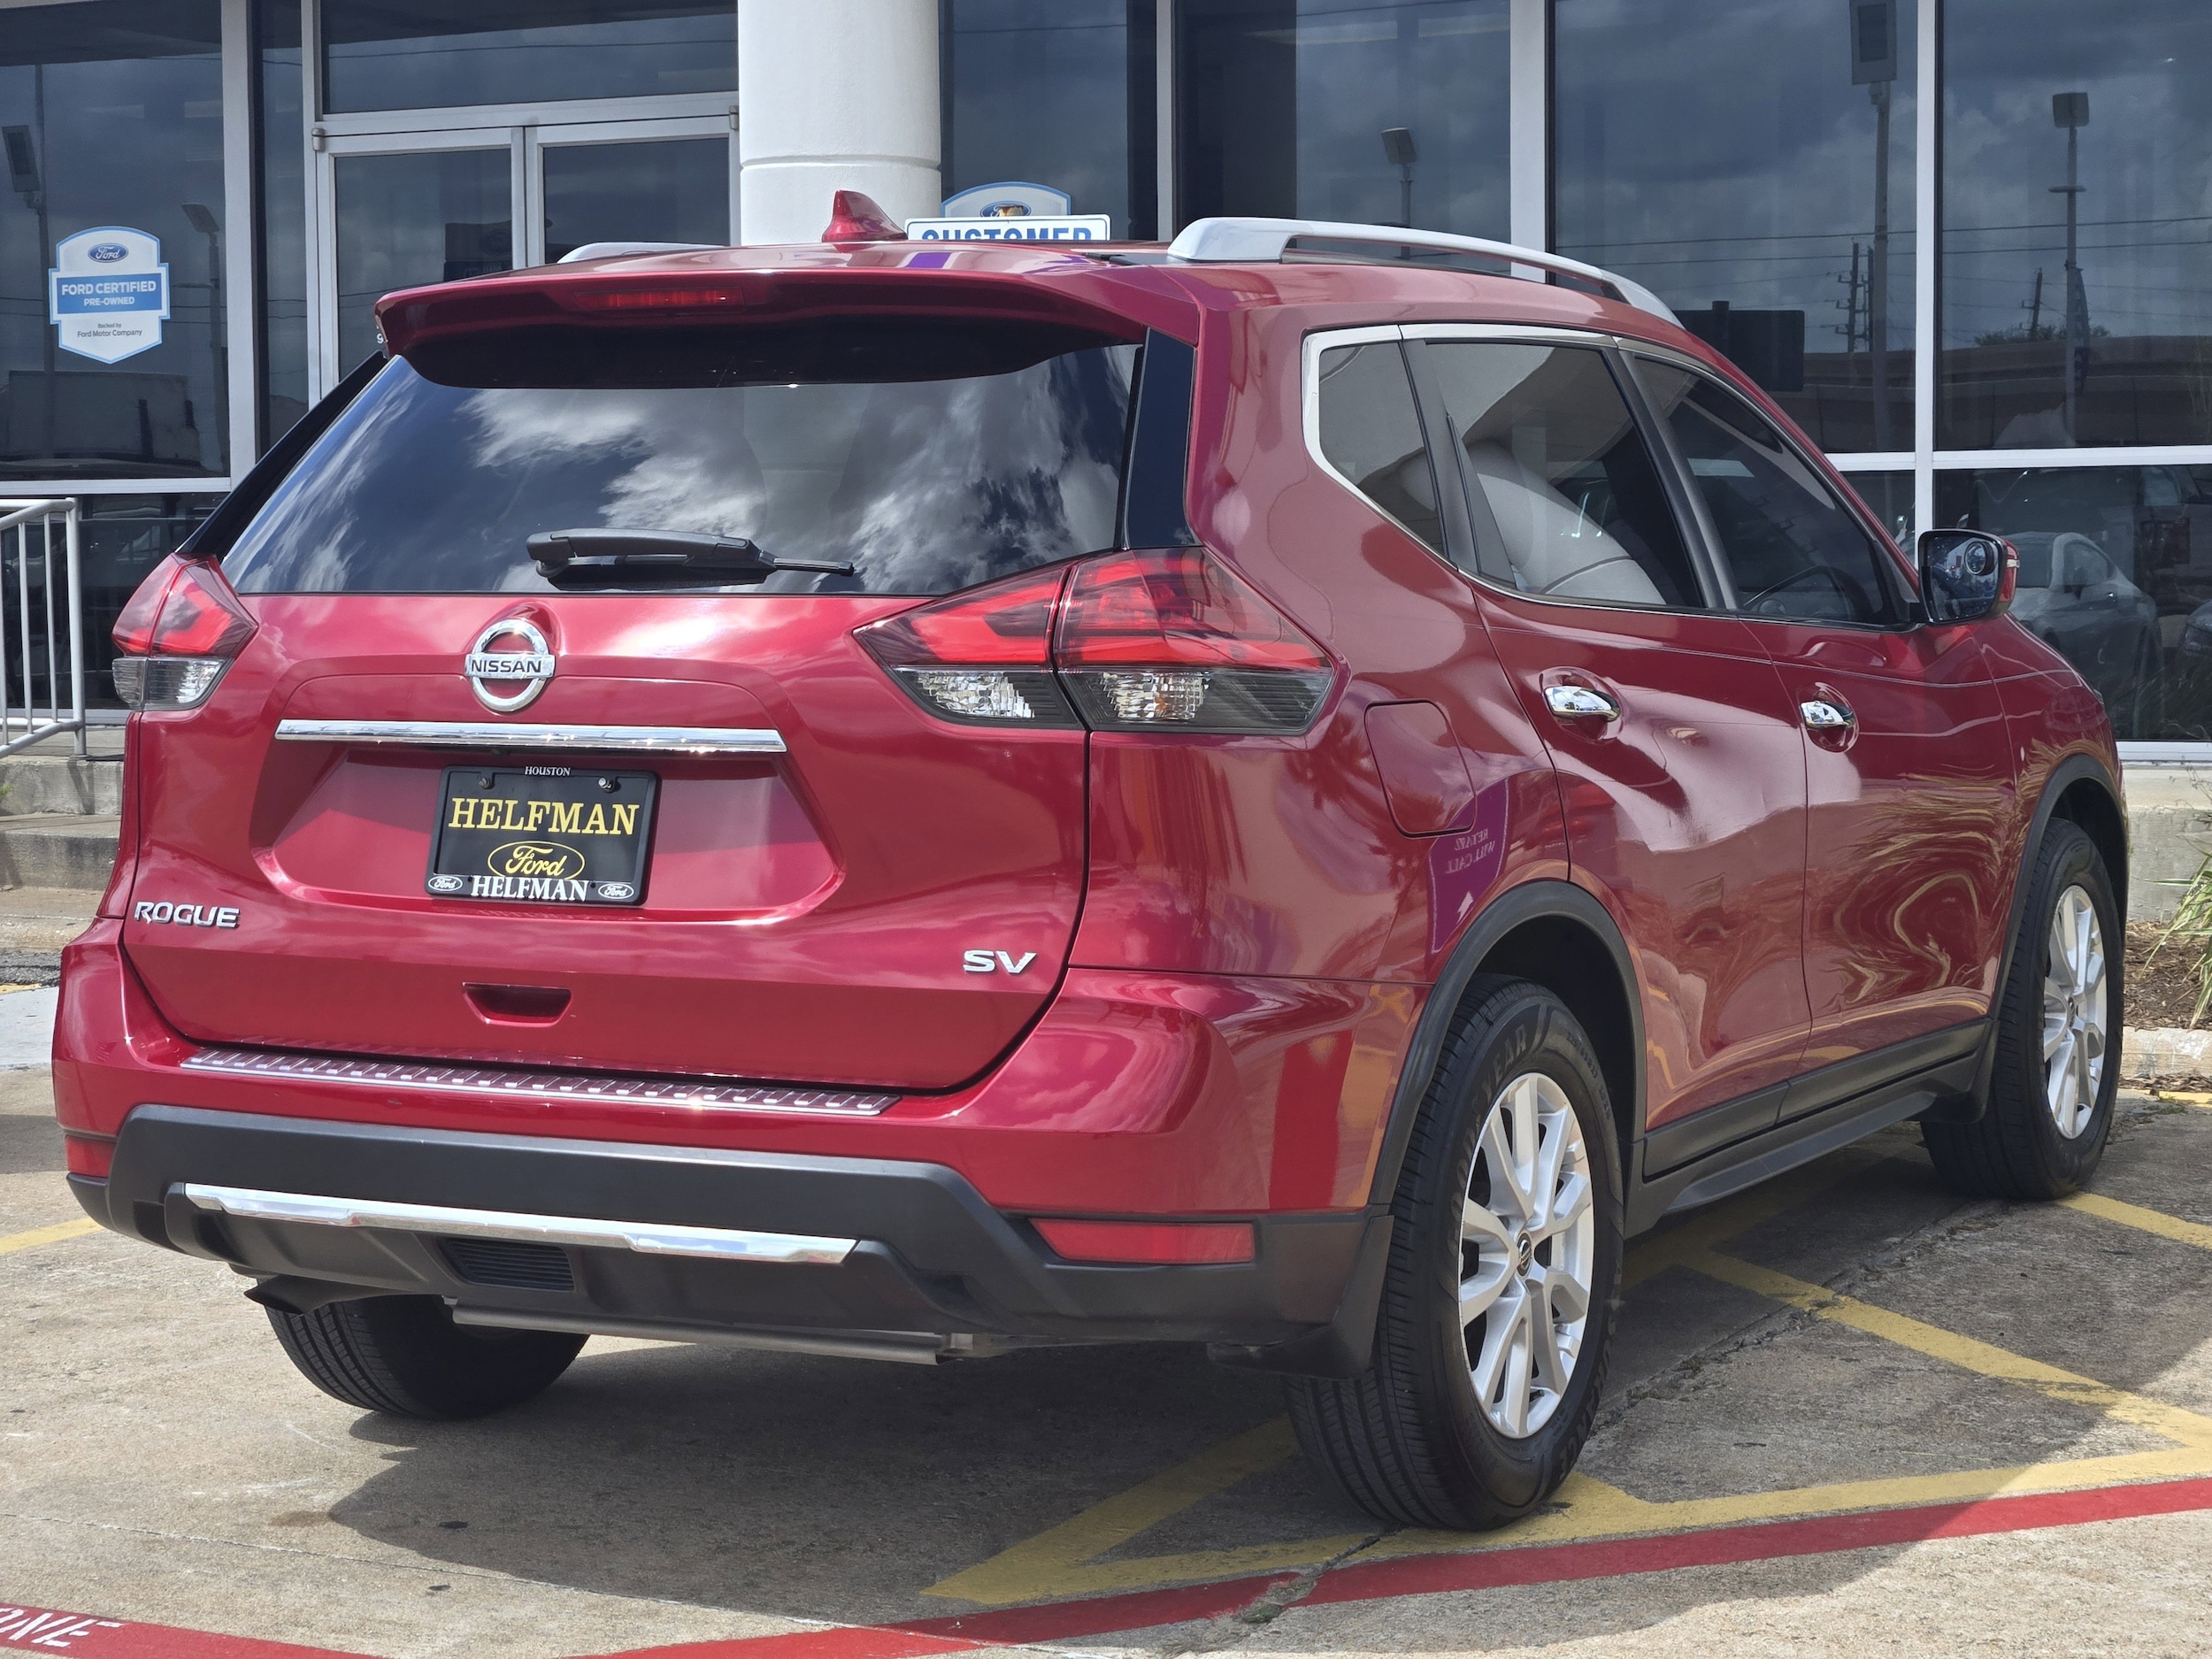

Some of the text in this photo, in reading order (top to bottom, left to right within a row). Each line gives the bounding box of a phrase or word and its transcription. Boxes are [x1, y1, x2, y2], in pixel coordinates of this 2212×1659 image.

[95, 245, 120, 260] Ford
[61, 280, 157, 296] FORD CERTIFIED
[83, 296, 135, 307] PRE-OWNED
[92, 329, 111, 338] Motor
[112, 328, 142, 337] Company
[471, 659, 541, 673] NISSAN
[524, 766, 572, 776] HOUSTON
[448, 797, 641, 835] HELFMAN
[504, 845, 567, 877] Ford
[434, 874, 628, 902] Ford HELFMAN Ford
[134, 901, 240, 928] ROGUE
[963, 949, 1038, 974] SV
